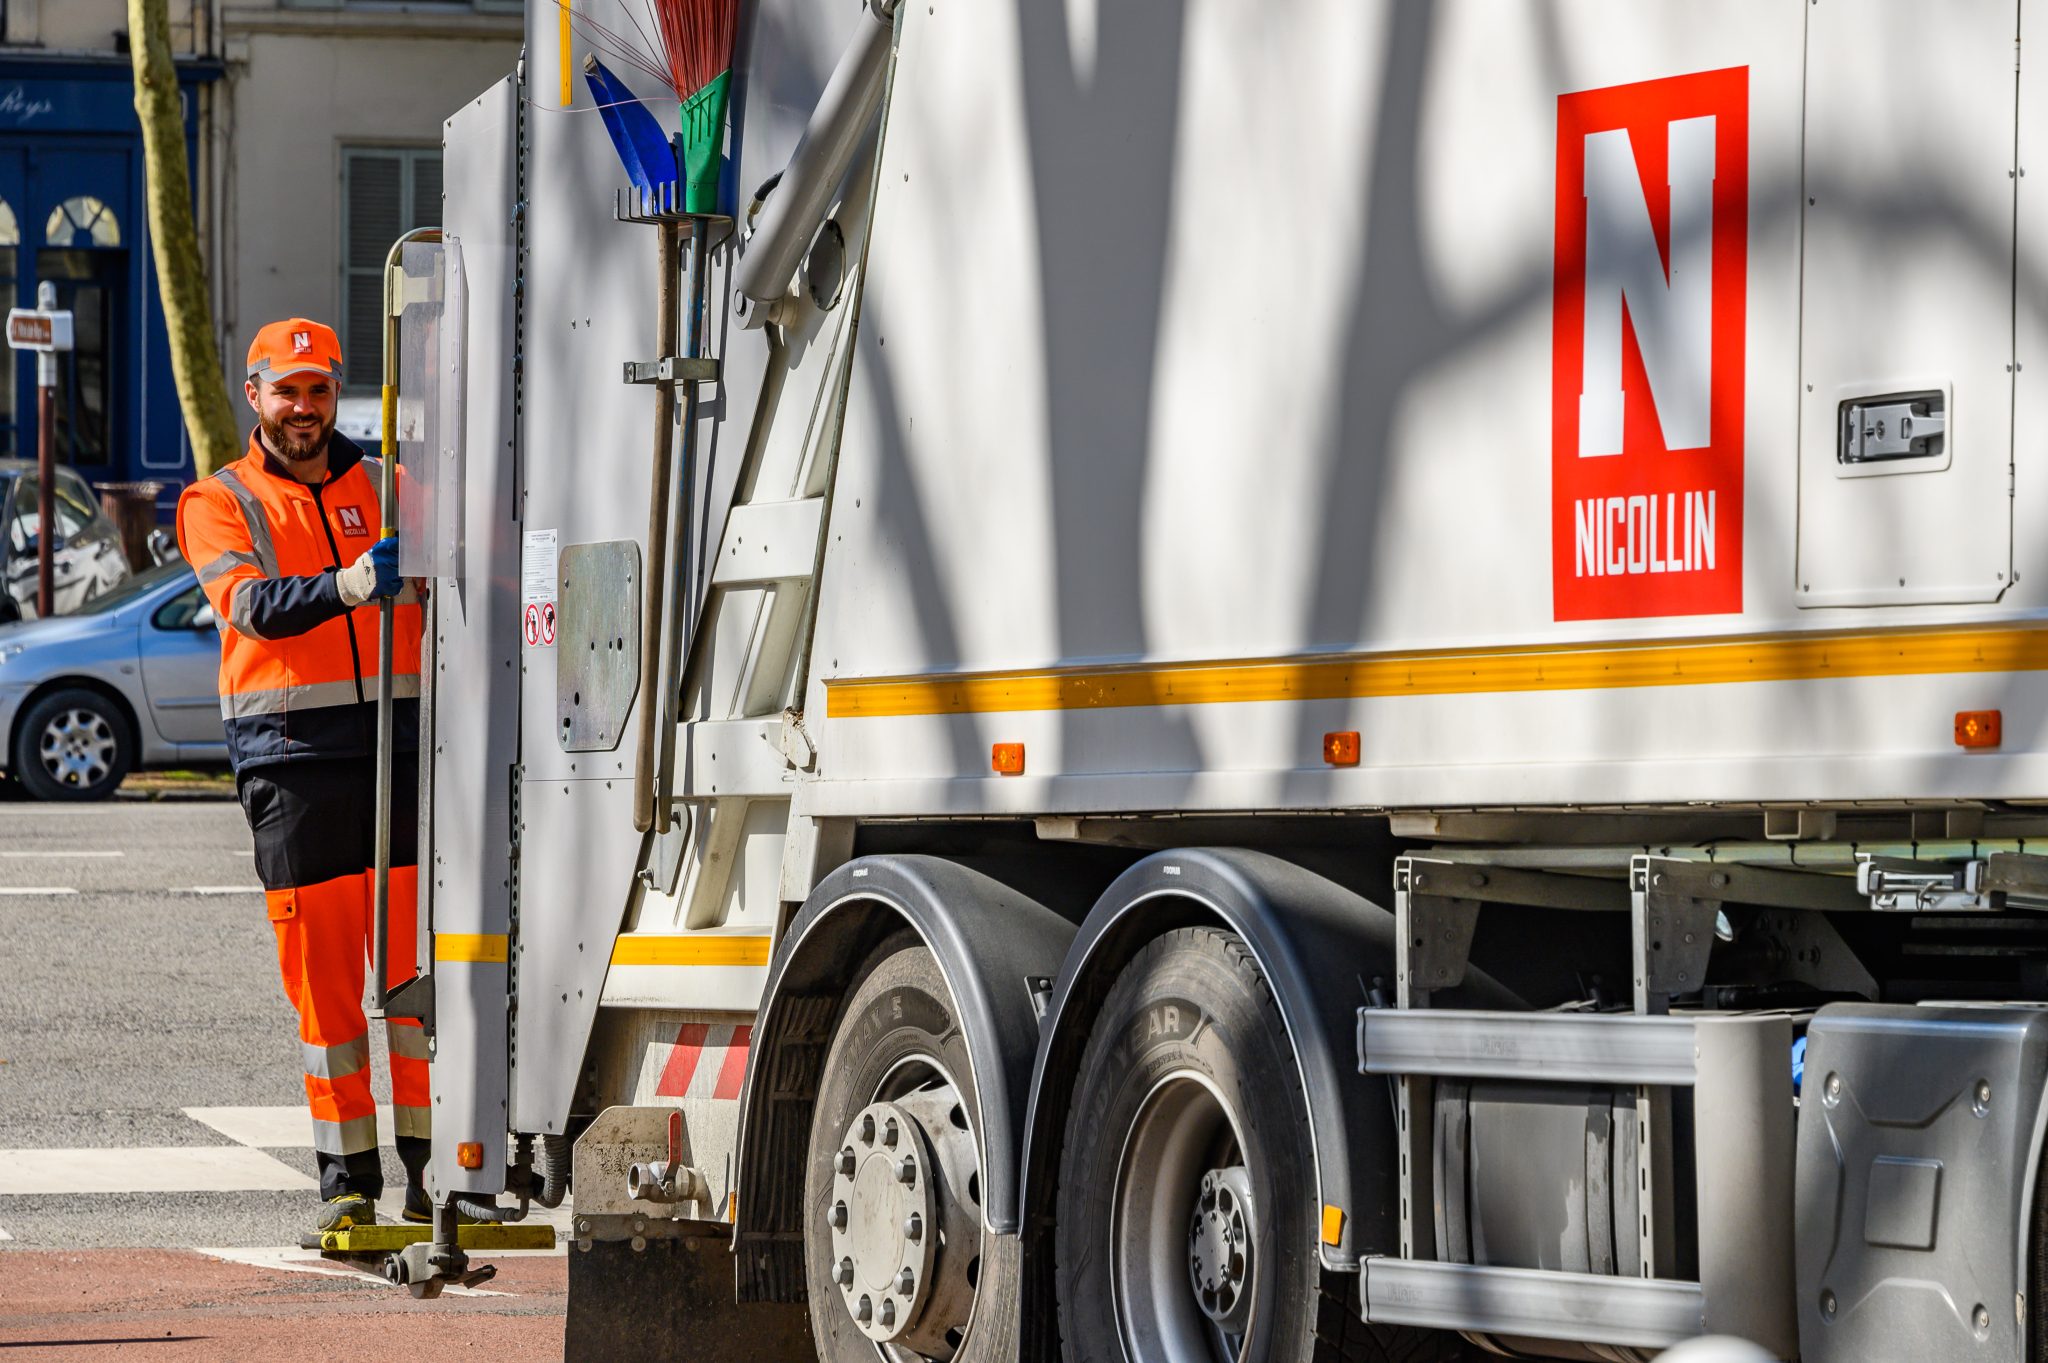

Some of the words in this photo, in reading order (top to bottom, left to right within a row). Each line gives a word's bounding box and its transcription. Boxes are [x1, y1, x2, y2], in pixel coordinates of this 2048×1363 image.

[1578, 115, 1717, 458] N
[294, 332, 309, 348] N
[339, 508, 361, 527] N
[1575, 490, 1716, 577] NICOLLIN
